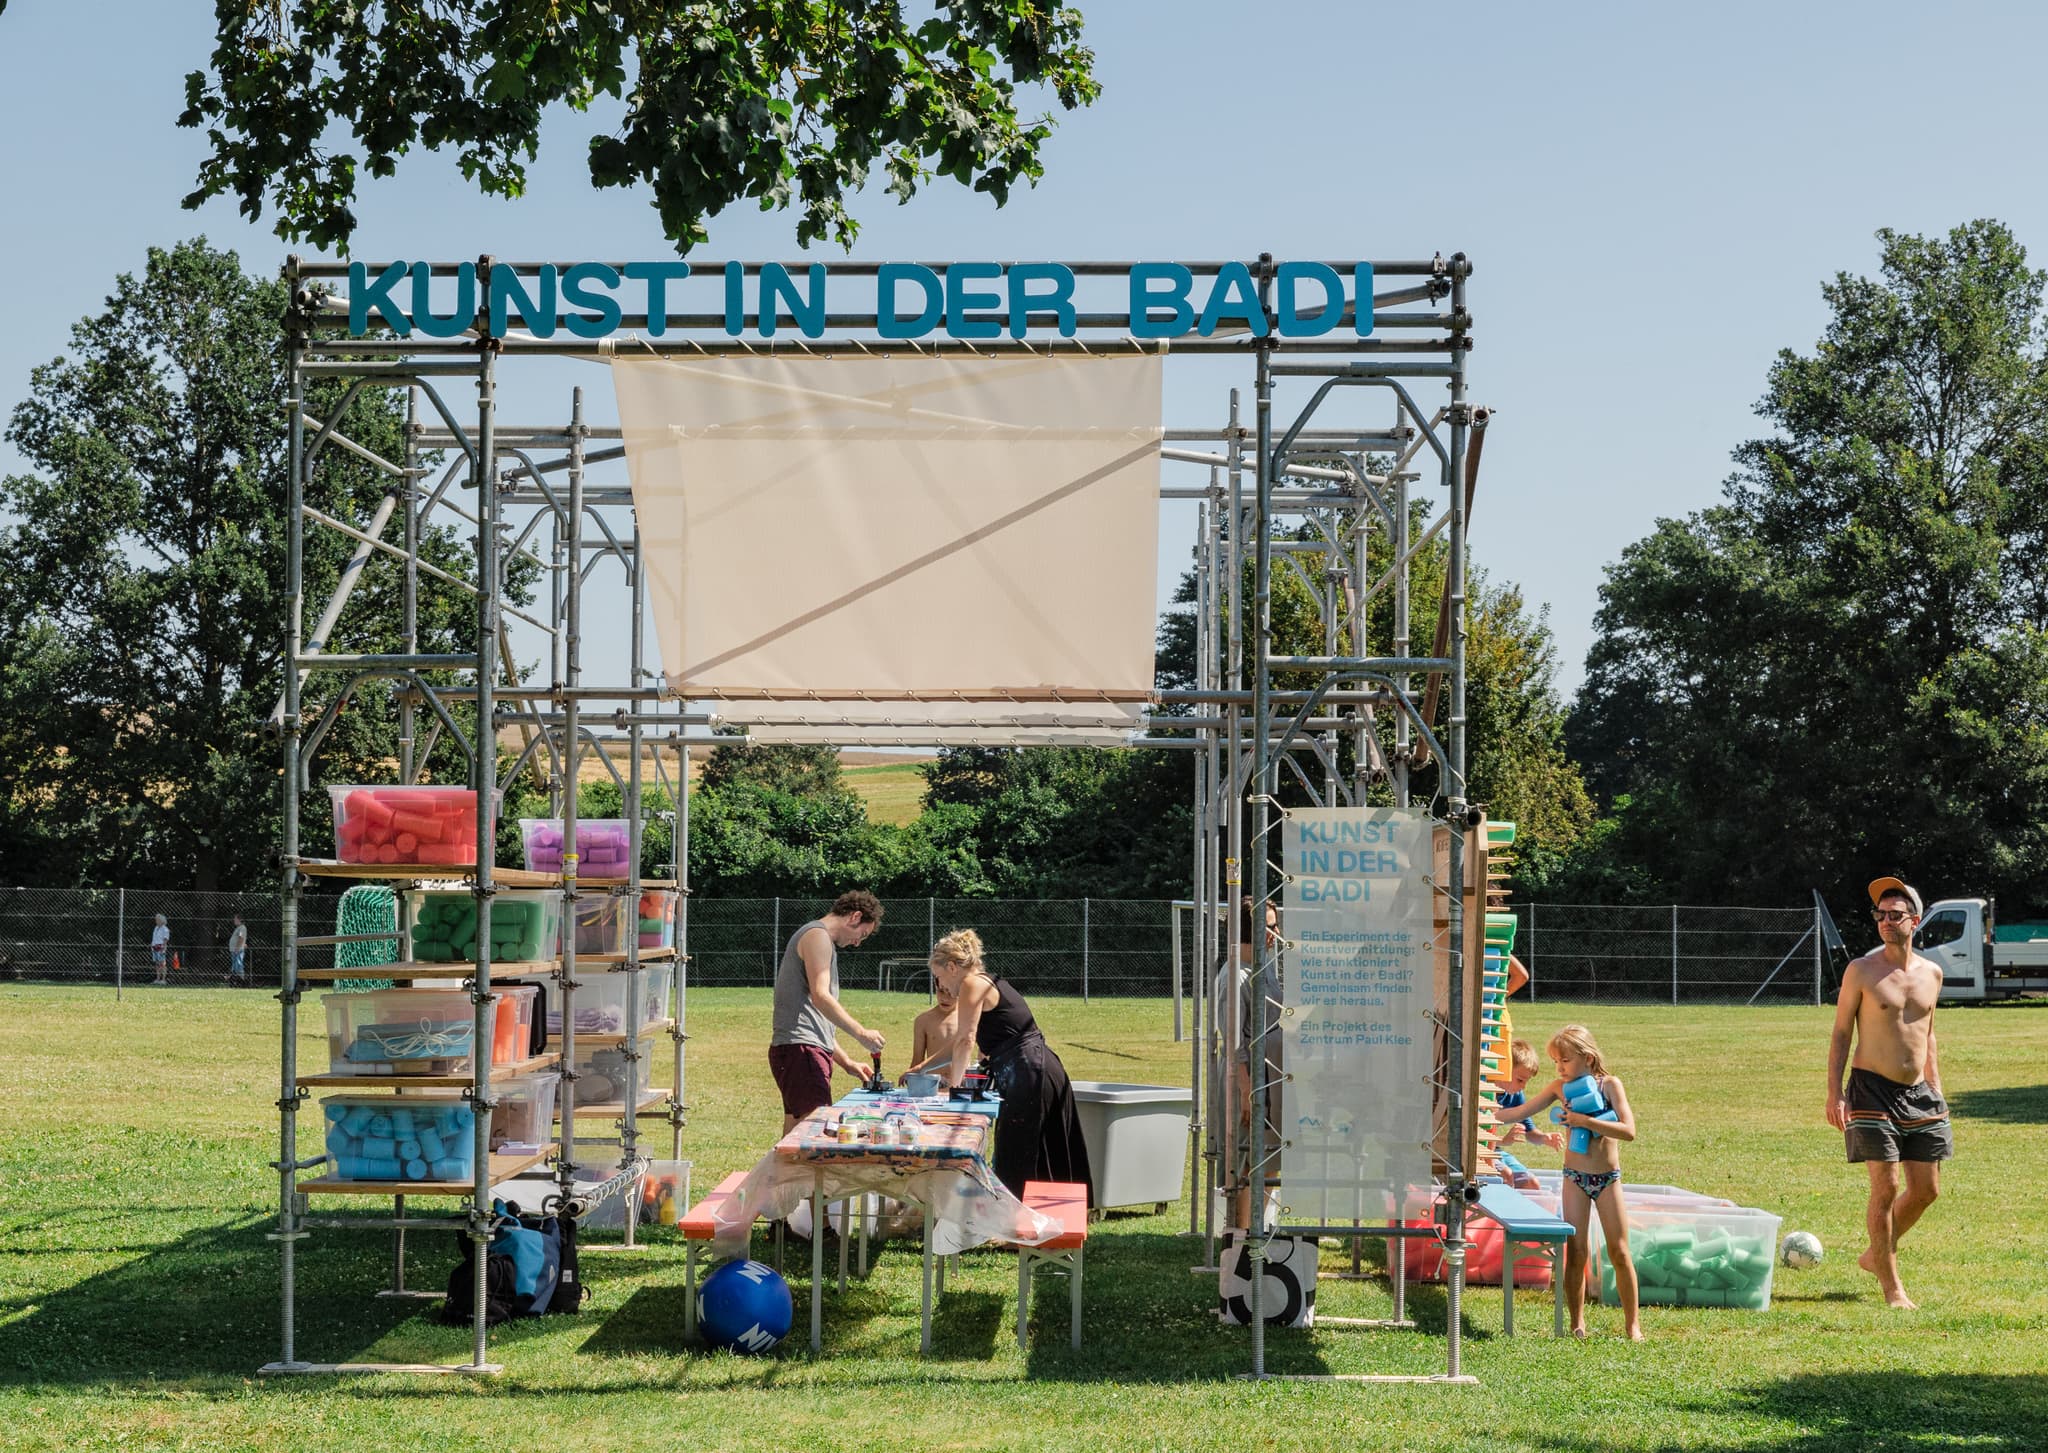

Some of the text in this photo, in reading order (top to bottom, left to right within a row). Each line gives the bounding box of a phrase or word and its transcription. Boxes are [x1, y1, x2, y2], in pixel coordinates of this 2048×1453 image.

[348, 260, 1374, 339] KUNST IN DER BADI
[1300, 821, 1400, 844] KUNST
[1301, 850, 1398, 873] IN DER
[1301, 879, 1371, 902] BADI
[1301, 931, 1412, 943] Ein Experiment der
[1326, 957, 1400, 967] funktioniert
[1301, 970, 1413, 981] Kunst in der Badi?
[1301, 982, 1412, 993] Gemeinsam finden
[1301, 996, 1384, 1006] wir es heraus.
[1301, 1021, 1392, 1034] Ein Projekt des
[1301, 1034, 1412, 1045] Zentrum Paul Klee
